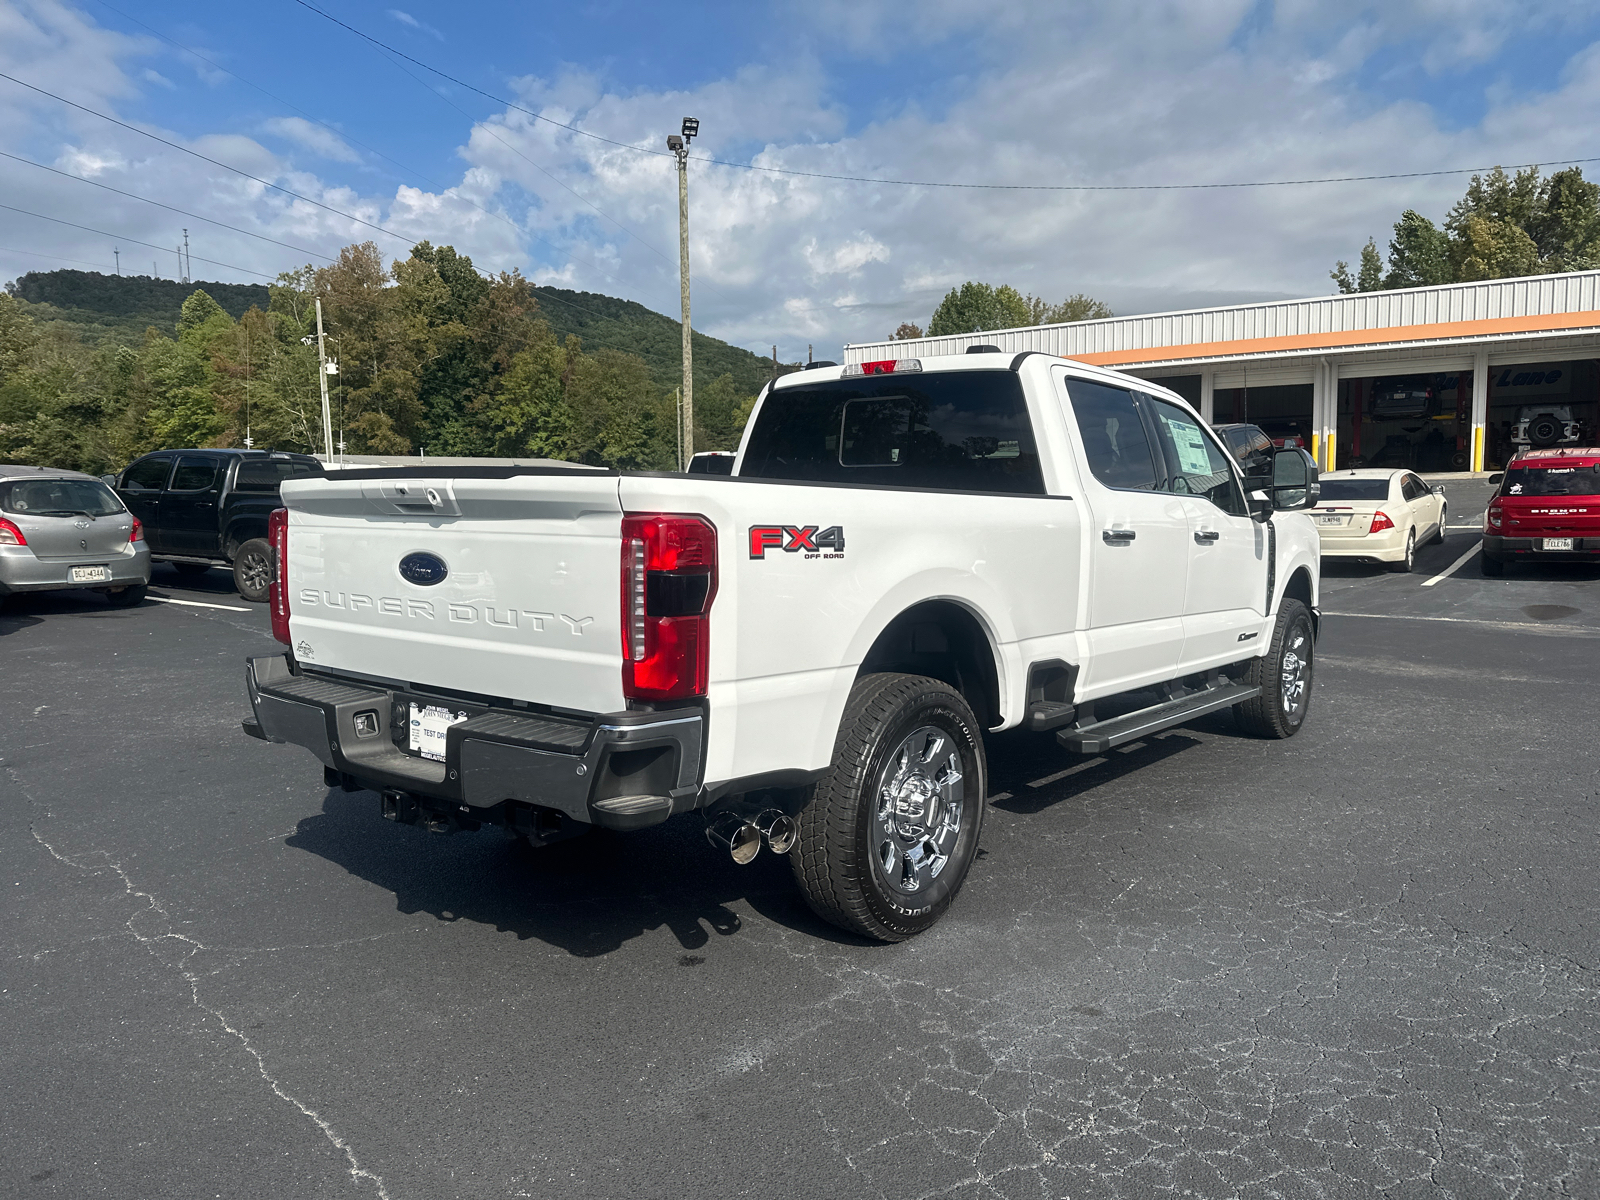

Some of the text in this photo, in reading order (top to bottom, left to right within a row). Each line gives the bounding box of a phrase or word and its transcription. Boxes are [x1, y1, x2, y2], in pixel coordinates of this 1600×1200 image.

[1495, 368, 1563, 388] Lane
[748, 524, 845, 560] FX4
[300, 588, 594, 636] SUPER DUTY
[424, 728, 436, 738] TEST
